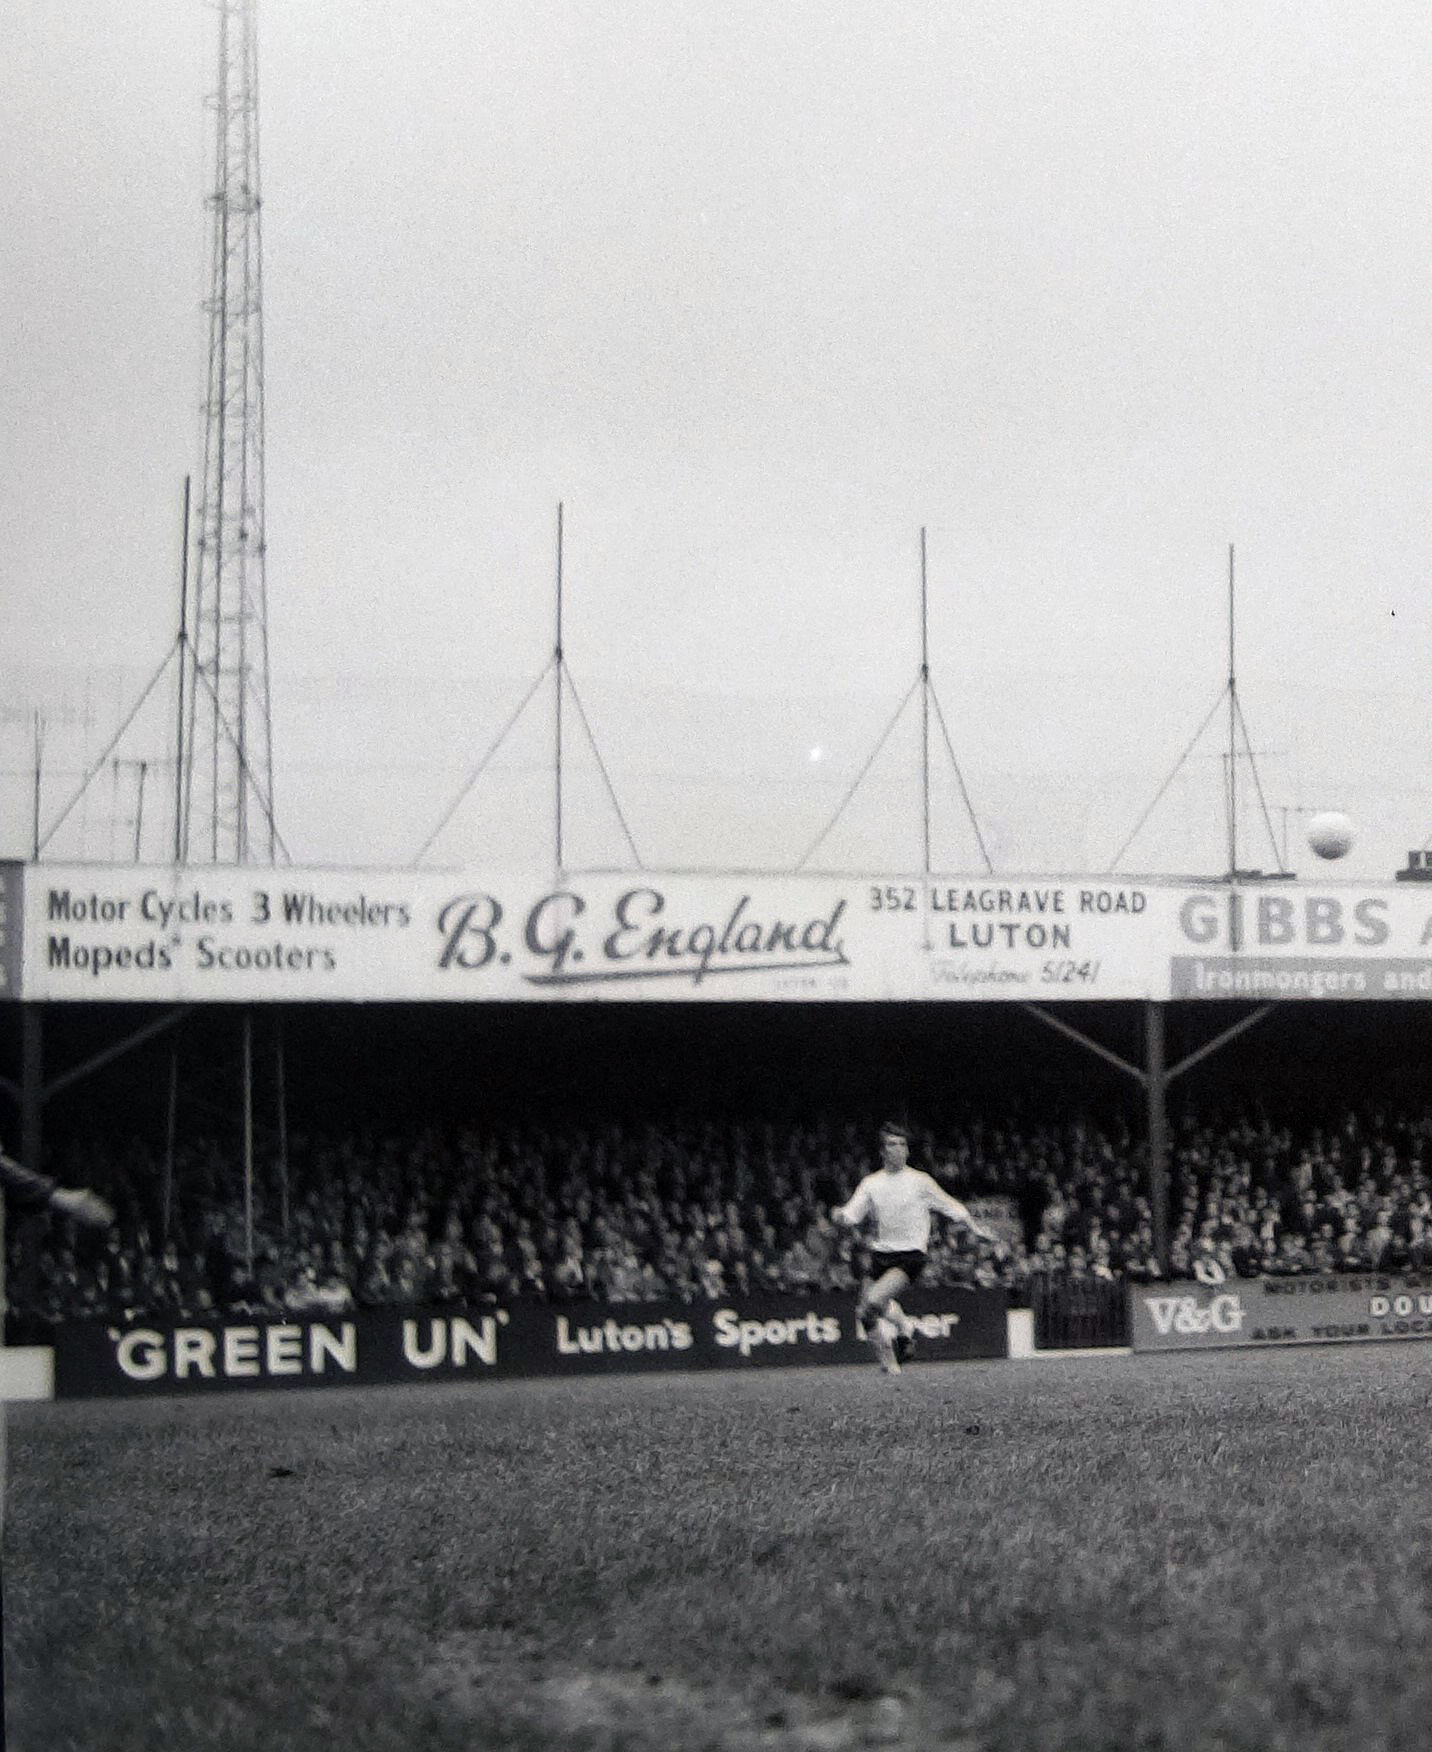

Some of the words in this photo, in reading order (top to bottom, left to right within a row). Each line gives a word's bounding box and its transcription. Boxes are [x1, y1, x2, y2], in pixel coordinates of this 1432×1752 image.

[47, 890, 130, 923] Motor
[141, 890, 234, 928] Cycles
[250, 891, 272, 924] 3
[282, 891, 412, 926] Wheelers
[870, 886, 918, 913] 352
[931, 887, 1066, 913] LEAGRAVE
[1079, 889, 1148, 914] ROAD
[602, 888, 850, 986] England
[949, 922, 1071, 950] LUTON
[1178, 894, 1390, 948] GIBBS
[196, 935, 338, 972] Scooters
[1194, 962, 1366, 997] Ironmongers
[555, 1314, 694, 1355] Luton's
[713, 1308, 843, 1357] Sports
[1144, 1292, 1247, 1337] V&G
